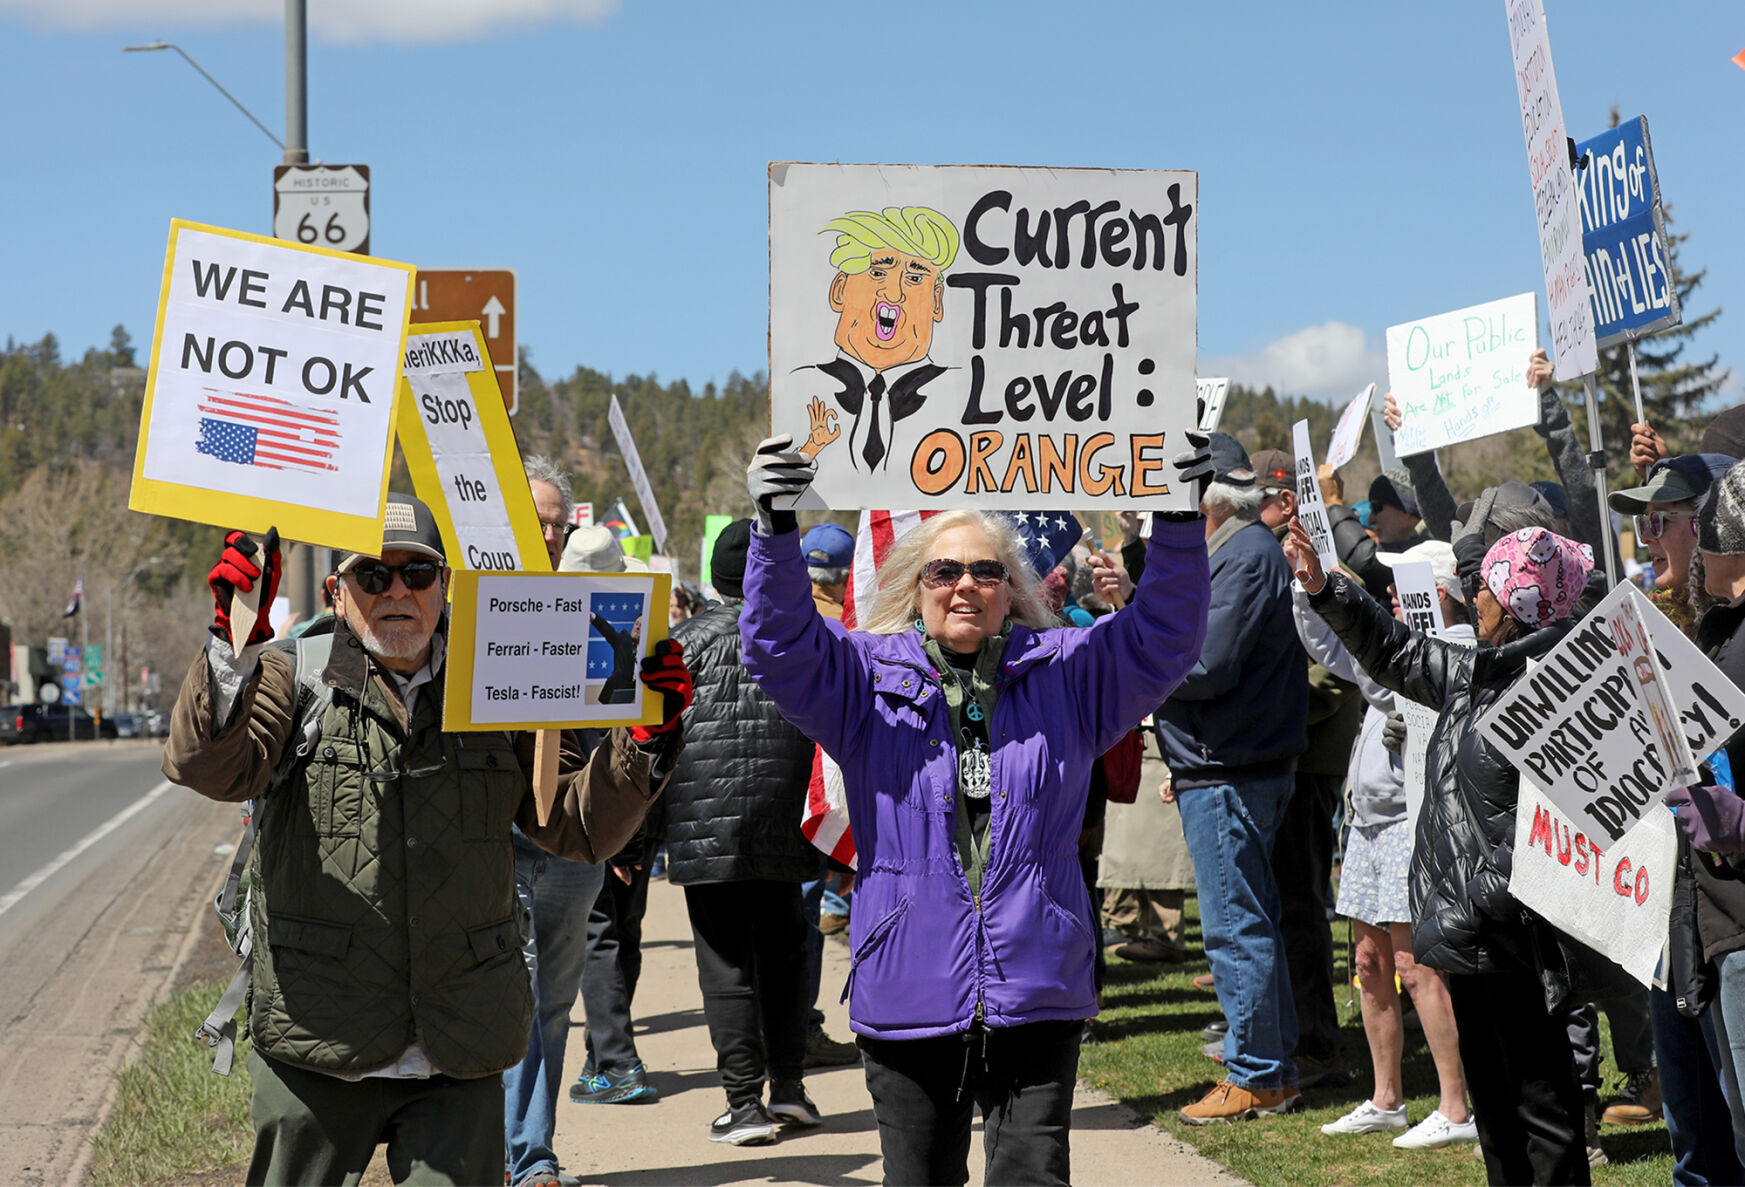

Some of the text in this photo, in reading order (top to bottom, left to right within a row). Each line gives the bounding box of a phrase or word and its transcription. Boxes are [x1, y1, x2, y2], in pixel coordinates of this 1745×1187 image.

[293, 178, 350, 188] HISTORIC
[1628, 145, 1646, 202] of
[297, 212, 346, 244] 66
[963, 183, 1193, 276] Current
[192, 260, 269, 308] WE
[281, 279, 386, 331] ARE
[946, 273, 1140, 350] Threat
[404, 339, 481, 368] eriKKKa,
[1406, 313, 1526, 371] Our Public
[181, 333, 375, 404] NOT OK
[1430, 364, 1472, 390] Lands
[421, 393, 472, 429] Stop
[910, 428, 1170, 498] ORANGE
[454, 474, 488, 502] the
[1298, 476, 1317, 506] FF!
[1301, 511, 1327, 537] OCIAL
[468, 544, 515, 570] Coup
[489, 598, 543, 612] Porsche
[555, 598, 583, 612] Fast
[1401, 592, 1431, 609] HANDS
[487, 641, 530, 656] Ferrari
[542, 641, 583, 656] Faster
[485, 686, 520, 700] Tesla
[531, 685, 581, 700] Fascist!
[1573, 751, 1608, 793] OF
[1528, 802, 1649, 906] MUST GO
